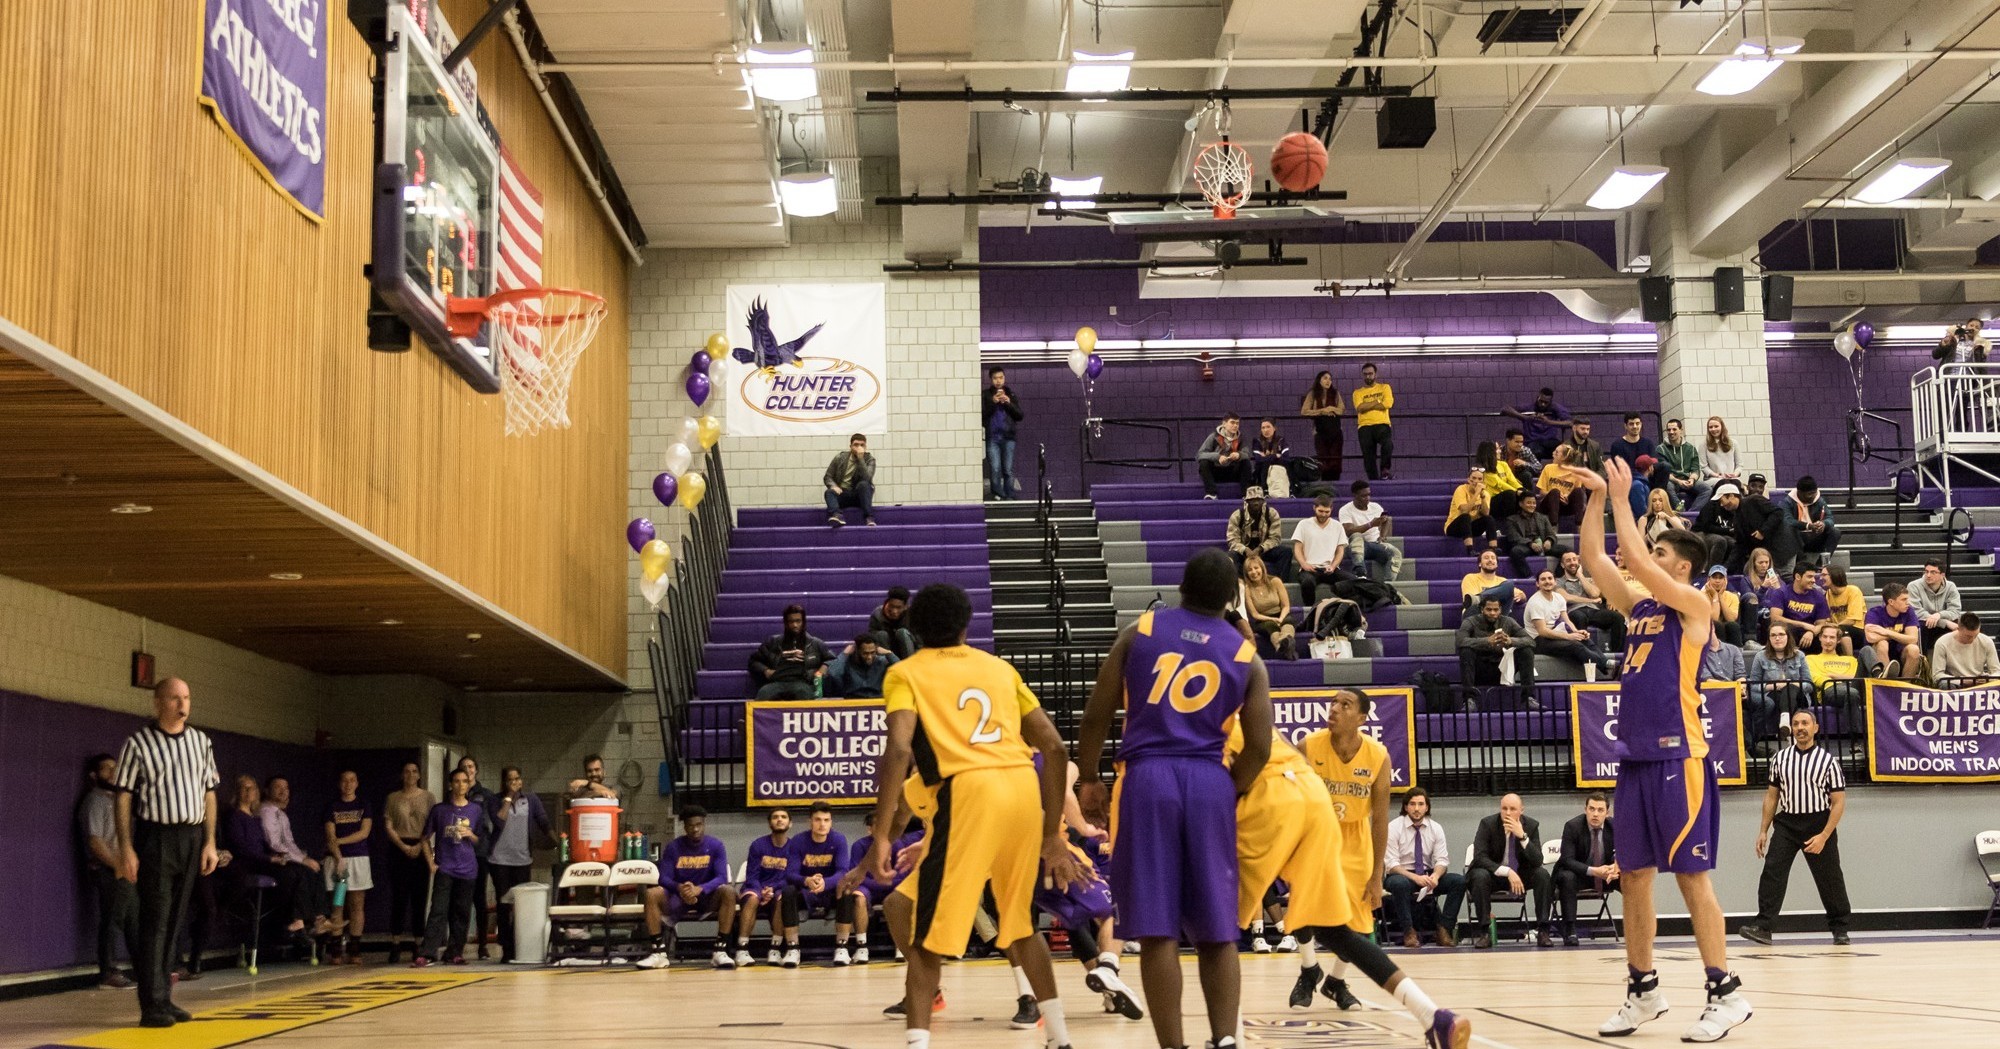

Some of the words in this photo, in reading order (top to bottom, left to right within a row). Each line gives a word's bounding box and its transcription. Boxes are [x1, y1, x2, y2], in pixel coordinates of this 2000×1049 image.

[210, 0, 322, 165] ATHLETICS
[771, 375, 856, 392] HUNTER
[765, 395, 850, 411] COLLEGE
[1147, 652, 1222, 714] 10
[1900, 690, 2000, 712] HUNTER
[782, 710, 888, 733] HUNTER
[957, 687, 1002, 745] 2
[1929, 740, 1979, 754] MEN'S
[796, 761, 876, 776] WOMEN'S
[1891, 758, 1956, 771] INDOOR
[1962, 758, 2000, 771] TRA
[760, 781, 845, 795] OUTDOOR
[569, 868, 605, 878] HUNTER
